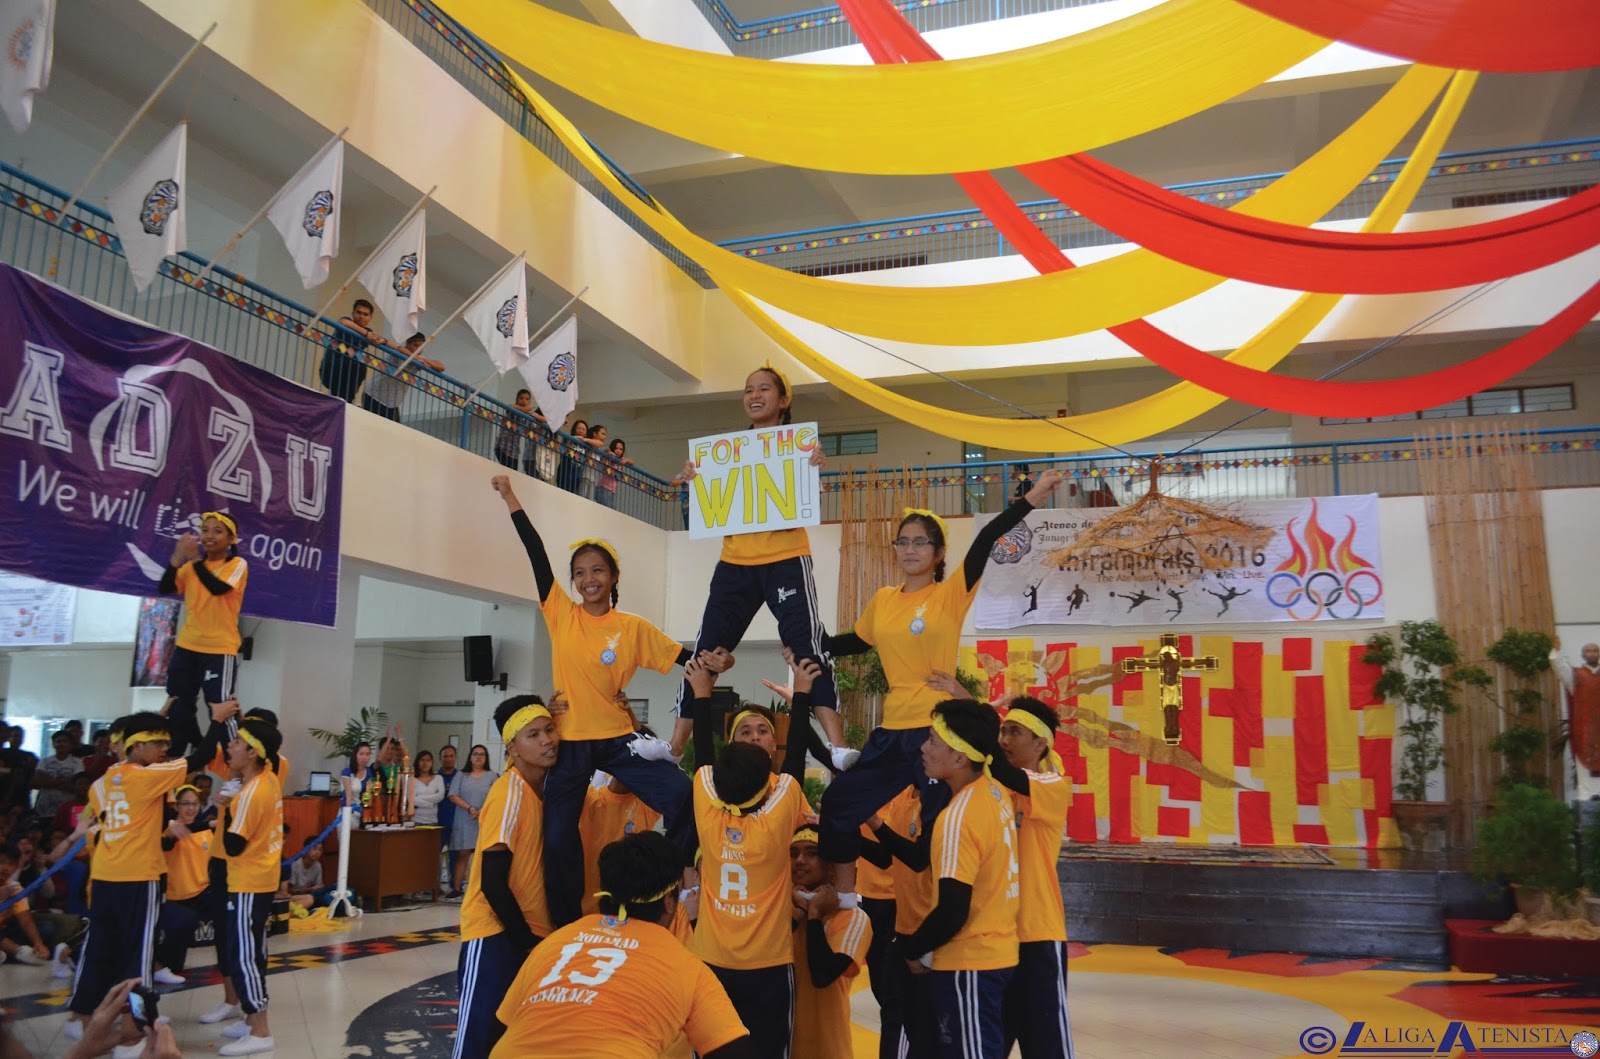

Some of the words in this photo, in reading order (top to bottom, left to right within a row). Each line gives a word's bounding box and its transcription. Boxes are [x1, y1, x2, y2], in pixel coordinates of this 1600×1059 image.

[0, 340, 332, 523] ADZU
[693, 457, 812, 529] WIN!
[18, 459, 78, 512] We
[90, 488, 147, 530] will
[250, 532, 323, 572] again
[1033, 520, 1078, 533] Ateneo
[1081, 519, 1094, 529] de
[1038, 533, 1069, 545] Junior
[1057, 543, 1195, 571] ntramurals
[1205, 542, 1266, 568] 2016
[1096, 573, 1114, 583] The
[1243, 570, 1265, 579] Live.
[572, 931, 640, 950] MOHAMAD
[538, 941, 629, 987] 13
